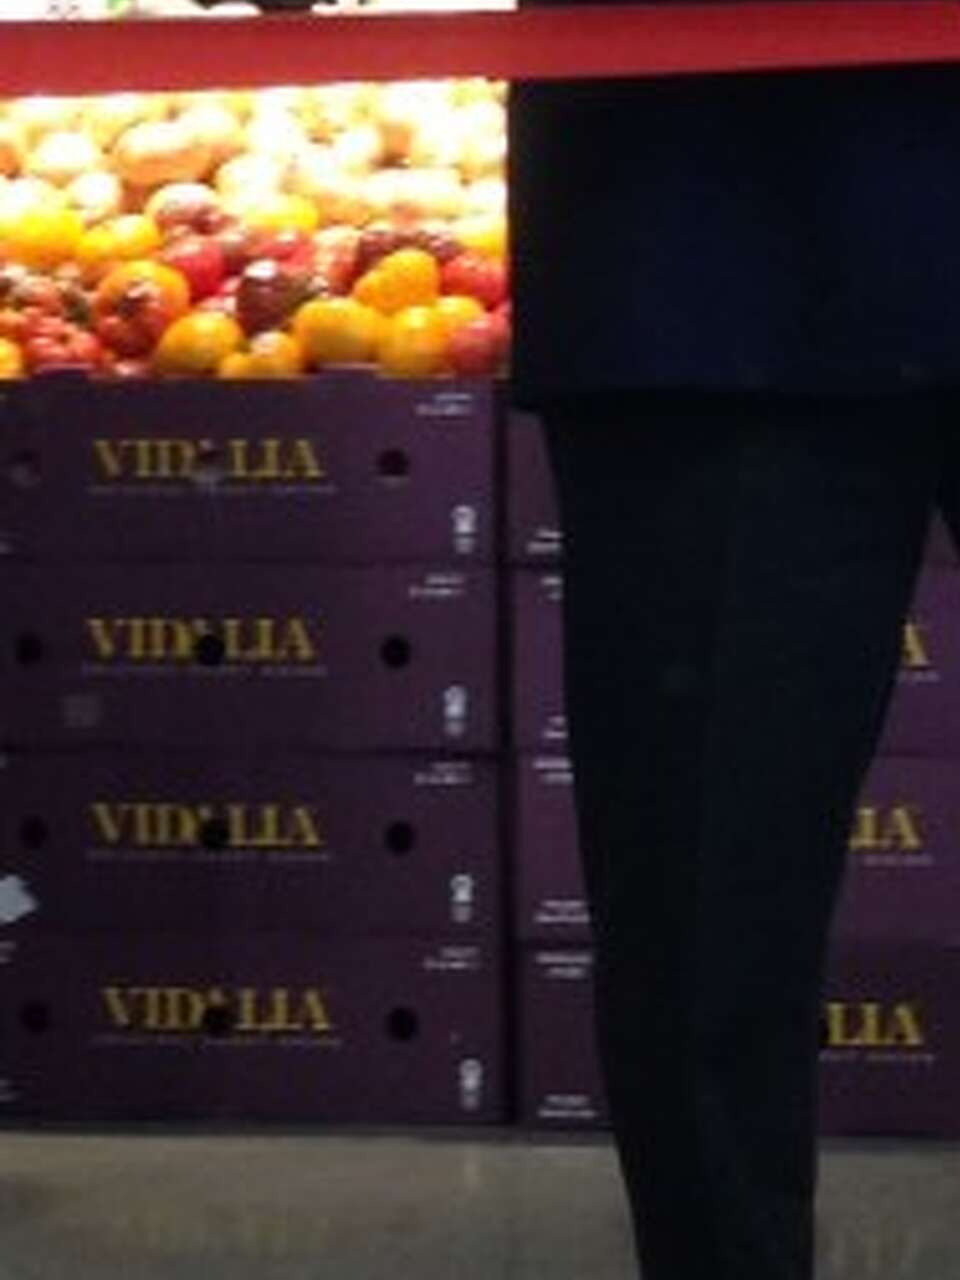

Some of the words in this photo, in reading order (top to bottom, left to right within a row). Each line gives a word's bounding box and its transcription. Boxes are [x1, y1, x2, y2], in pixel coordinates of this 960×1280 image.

[92, 438, 327, 480] VIDLIA
[86, 617, 317, 662] VIDLIA
[90, 802, 323, 847] VIDLIA
[102, 986, 331, 1031] VIDLIA
